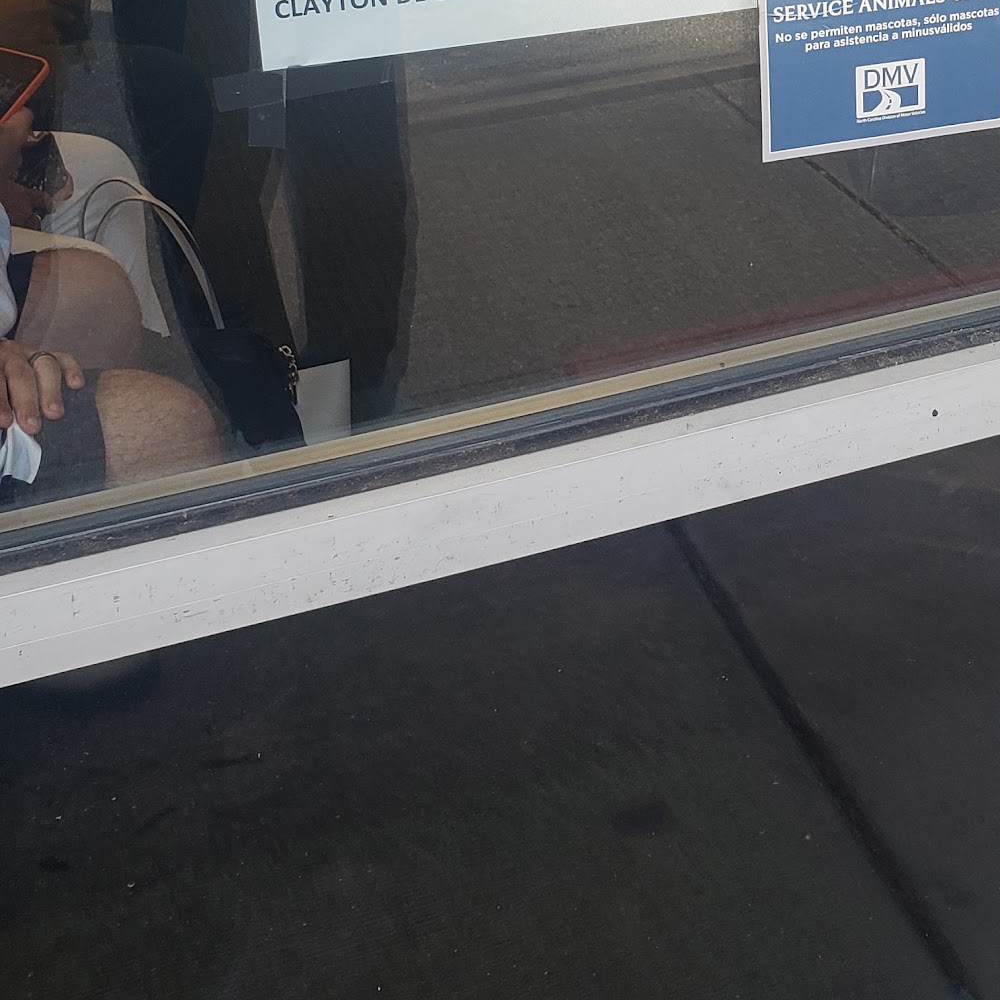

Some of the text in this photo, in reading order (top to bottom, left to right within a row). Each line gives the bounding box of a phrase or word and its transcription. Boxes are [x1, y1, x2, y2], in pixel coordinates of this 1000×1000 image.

[775, 7, 1000, 44] No se permiten mascotas, sólo mascotas
[805, 21, 973, 53] para asistencia a minusválidos
[864, 63, 919, 90] DMV
